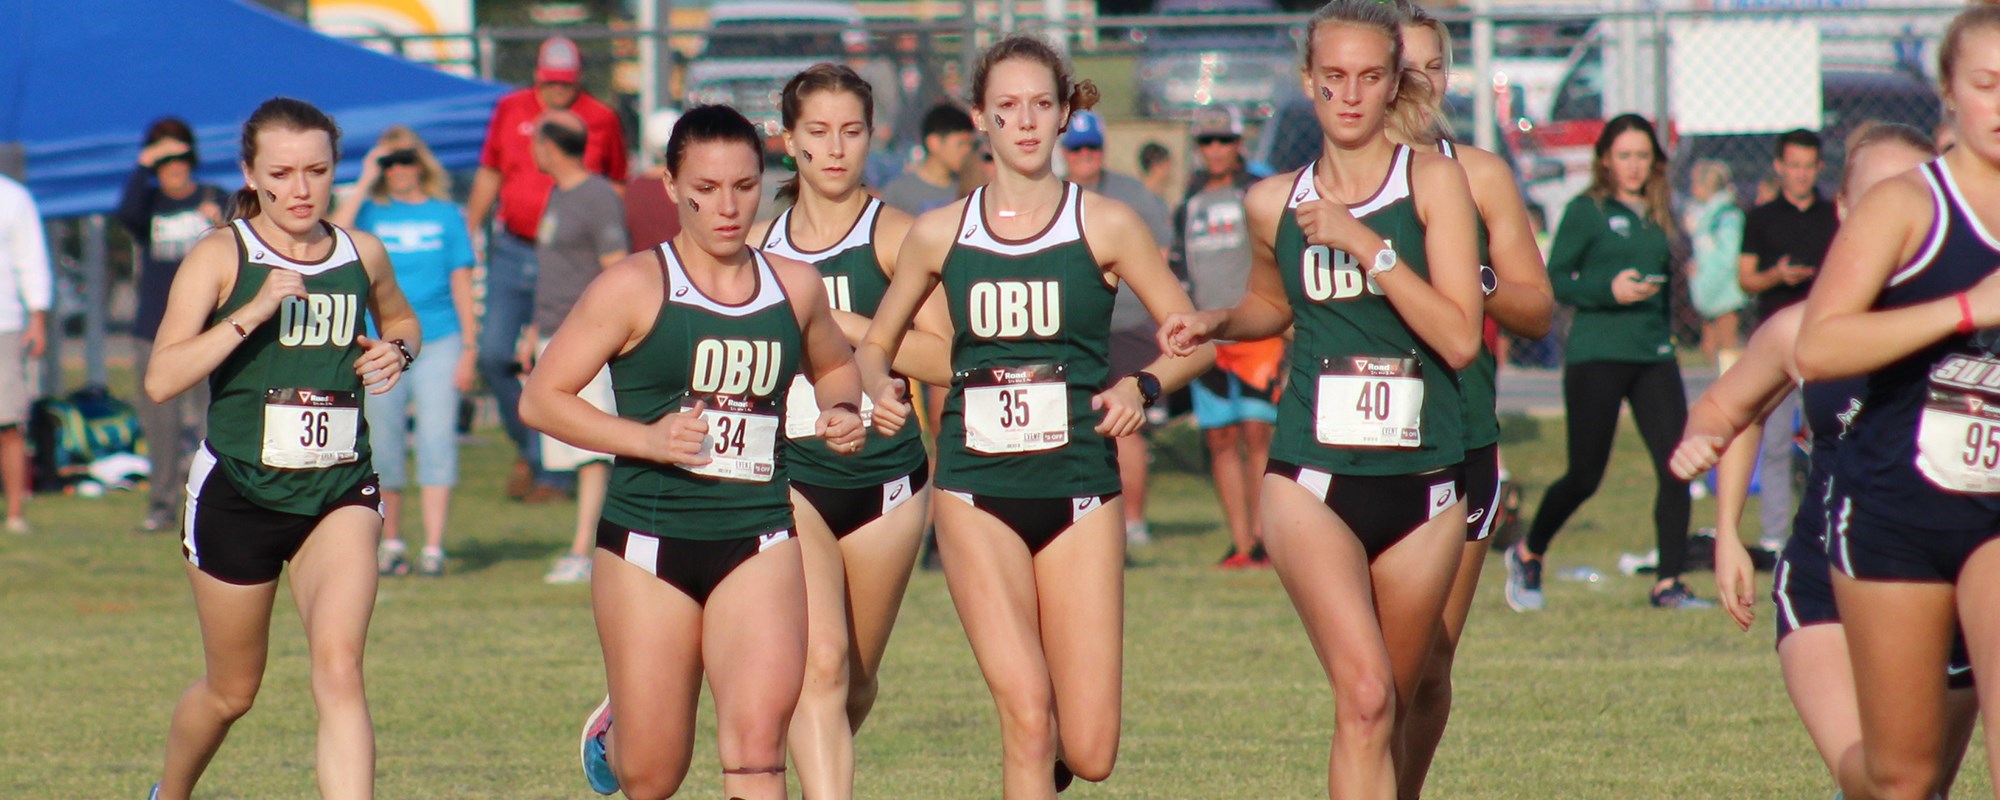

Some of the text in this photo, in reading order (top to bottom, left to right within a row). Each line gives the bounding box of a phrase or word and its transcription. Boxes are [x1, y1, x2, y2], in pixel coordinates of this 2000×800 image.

[279, 293, 357, 347] OBU
[969, 281, 1060, 338] OBU
[692, 338, 781, 396] OBU
[999, 388, 1030, 429] 35
[1356, 381, 1390, 420] 40
[300, 411, 329, 448] 36
[715, 416, 746, 456] 34
[1963, 422, 2000, 470] 95
